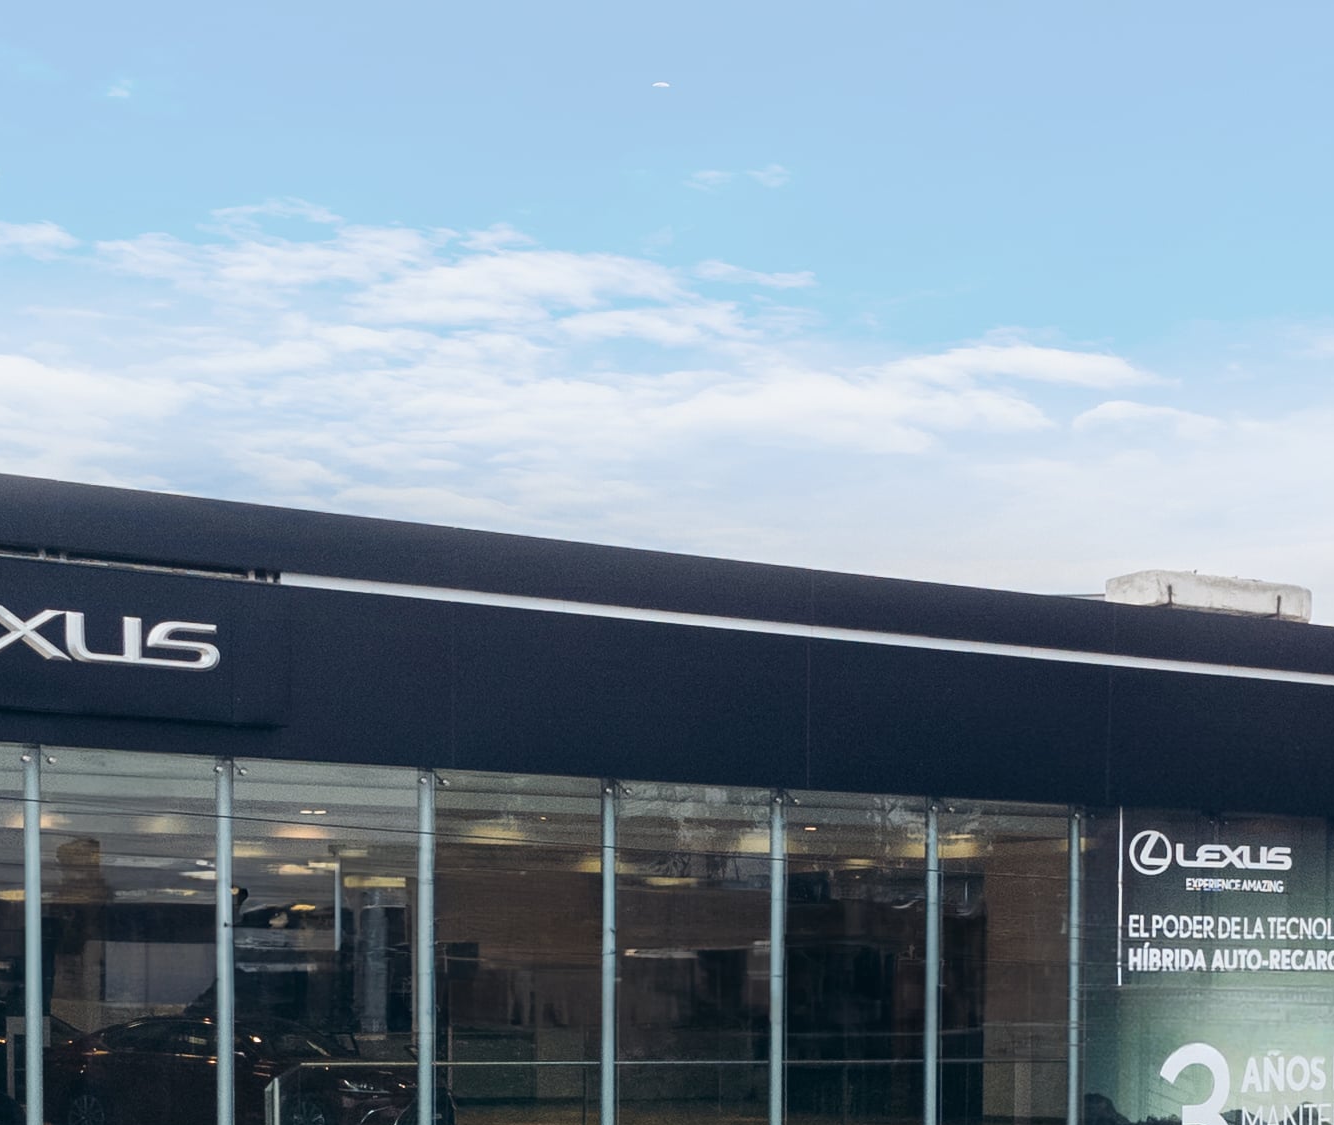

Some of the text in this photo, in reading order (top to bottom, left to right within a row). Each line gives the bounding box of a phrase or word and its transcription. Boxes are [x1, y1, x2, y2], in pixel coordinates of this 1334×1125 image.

[1175, 843, 1293, 871] LEXUS
[1185, 877, 1285, 893] EXPERIENCE AMAZING
[1128, 914, 1149, 938] EL
[1151, 914, 1215, 939] PODER
[1218, 916, 1241, 940] DE
[1243, 916, 1264, 940] LA
[1128, 942, 1207, 972] HÍBRIDA
[1240, 1050, 1327, 1094] AÑOS
